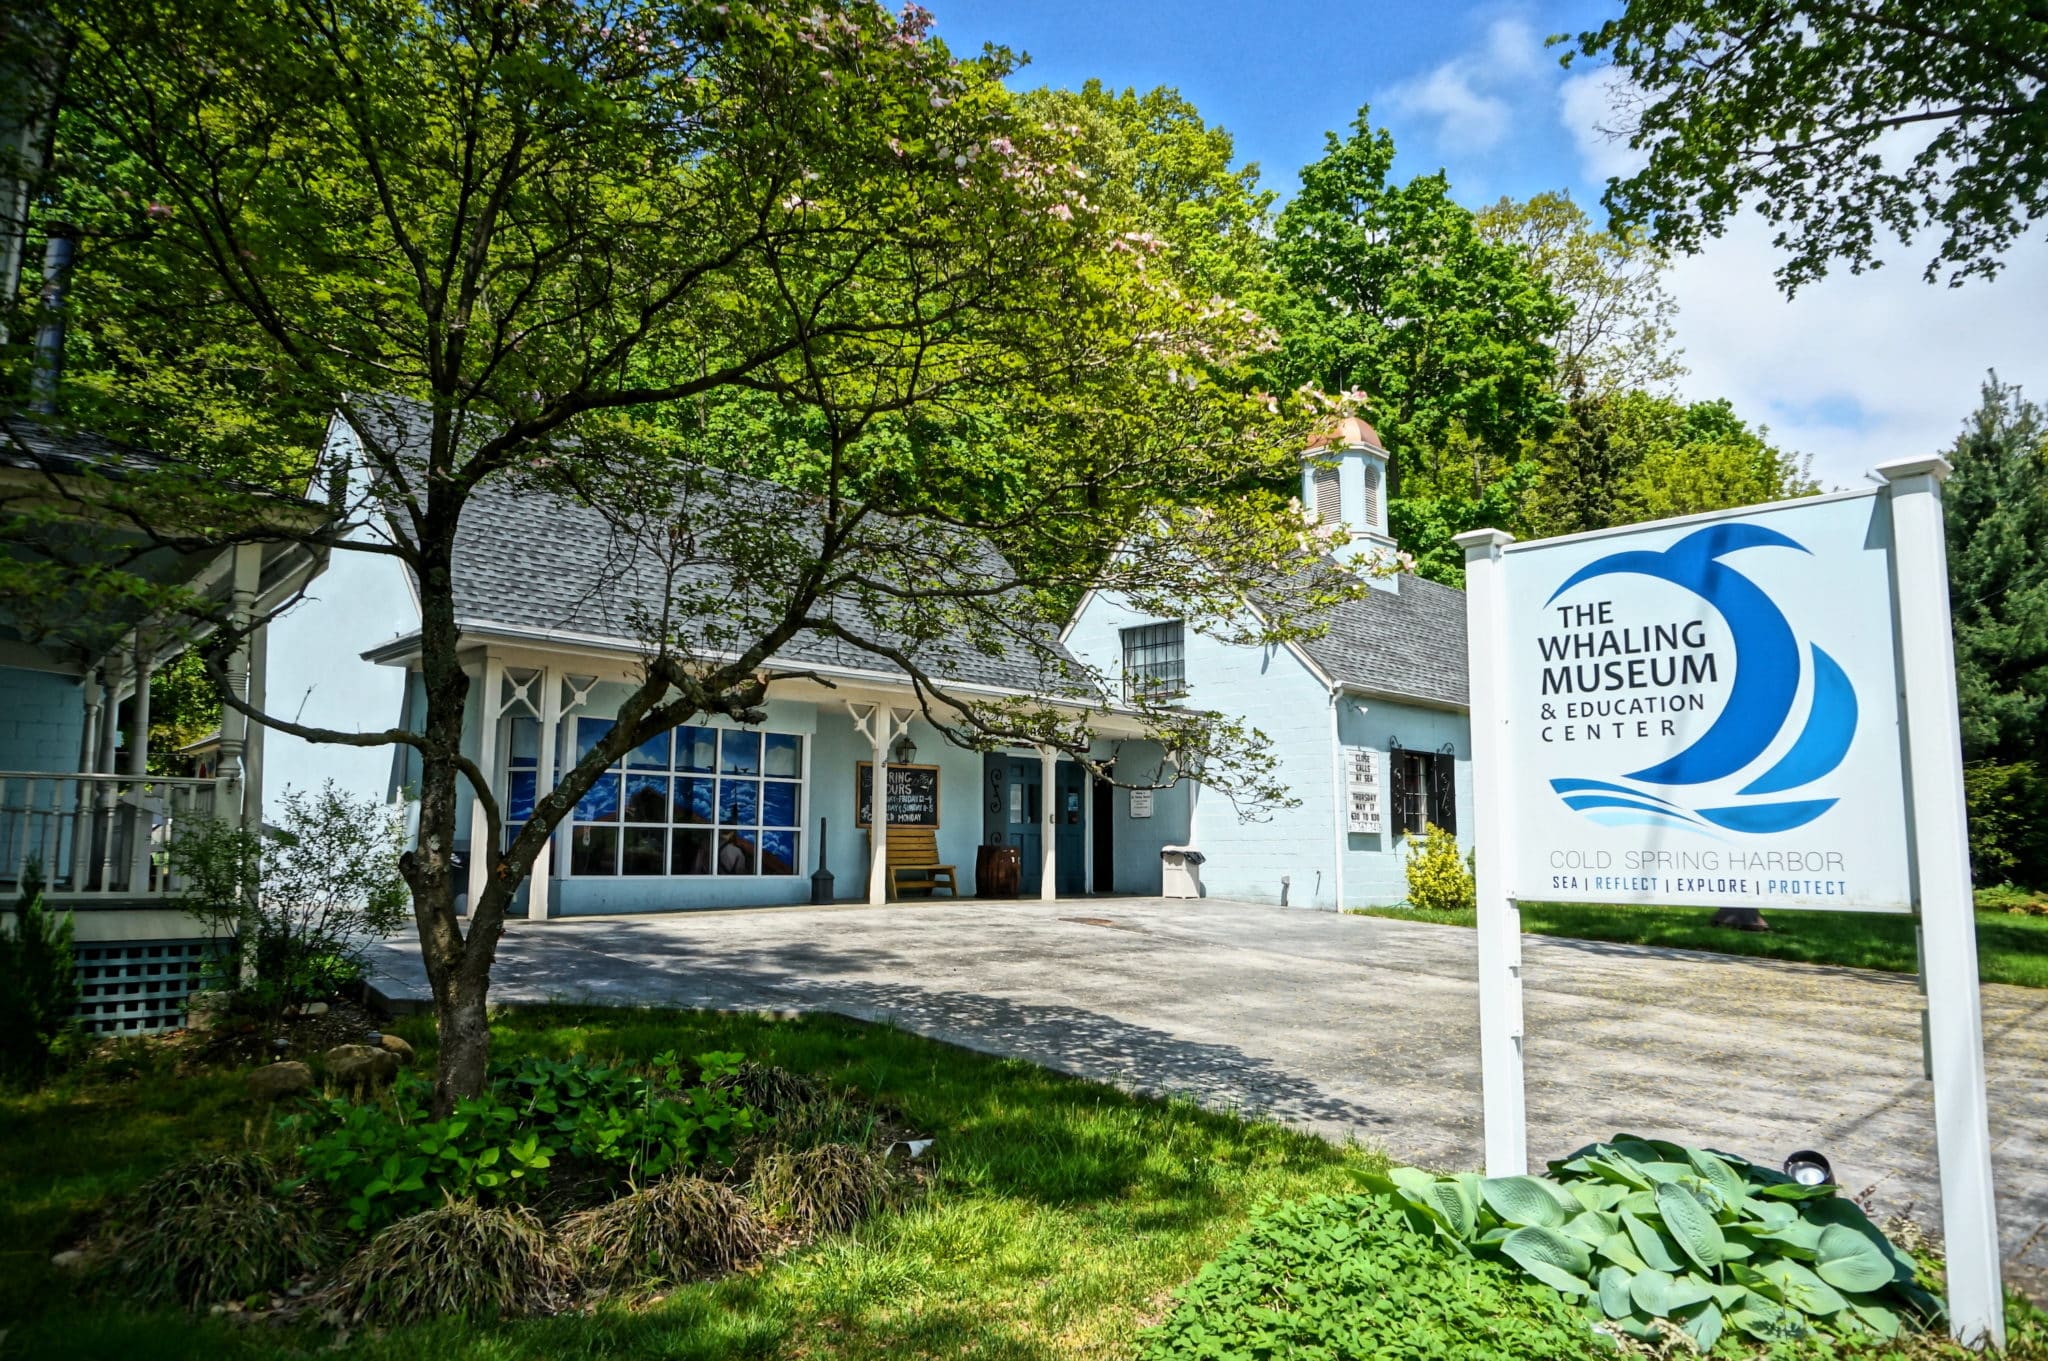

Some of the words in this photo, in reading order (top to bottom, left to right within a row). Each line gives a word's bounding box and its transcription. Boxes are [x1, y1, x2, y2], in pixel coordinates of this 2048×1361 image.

[1557, 601, 1614, 628] THE
[1538, 620, 1706, 662] WHALING
[1542, 652, 1718, 696] MUSEUM
[1541, 703, 1557, 721] &
[1567, 693, 1704, 719] EDUCATION
[1542, 719, 1676, 743] CENTER
[1355, 764, 1371, 773] CALLS
[1355, 774, 1362, 782] AT
[1364, 775, 1373, 783] SEA
[1352, 793, 1377, 802] THURSDAY
[1355, 803, 1366, 811] MAY
[897, 813, 922, 823] MONDAY
[1362, 812, 1369, 821] TO
[1550, 850, 1612, 869] COLD
[1625, 850, 1719, 871] SPRING
[1728, 851, 1845, 872] HARBOR
[1553, 876, 1578, 889] SEA
[1595, 876, 1657, 891] REFLECT
[1677, 878, 1748, 892] EXPLORE
[1768, 879, 1846, 895] PROTECT
